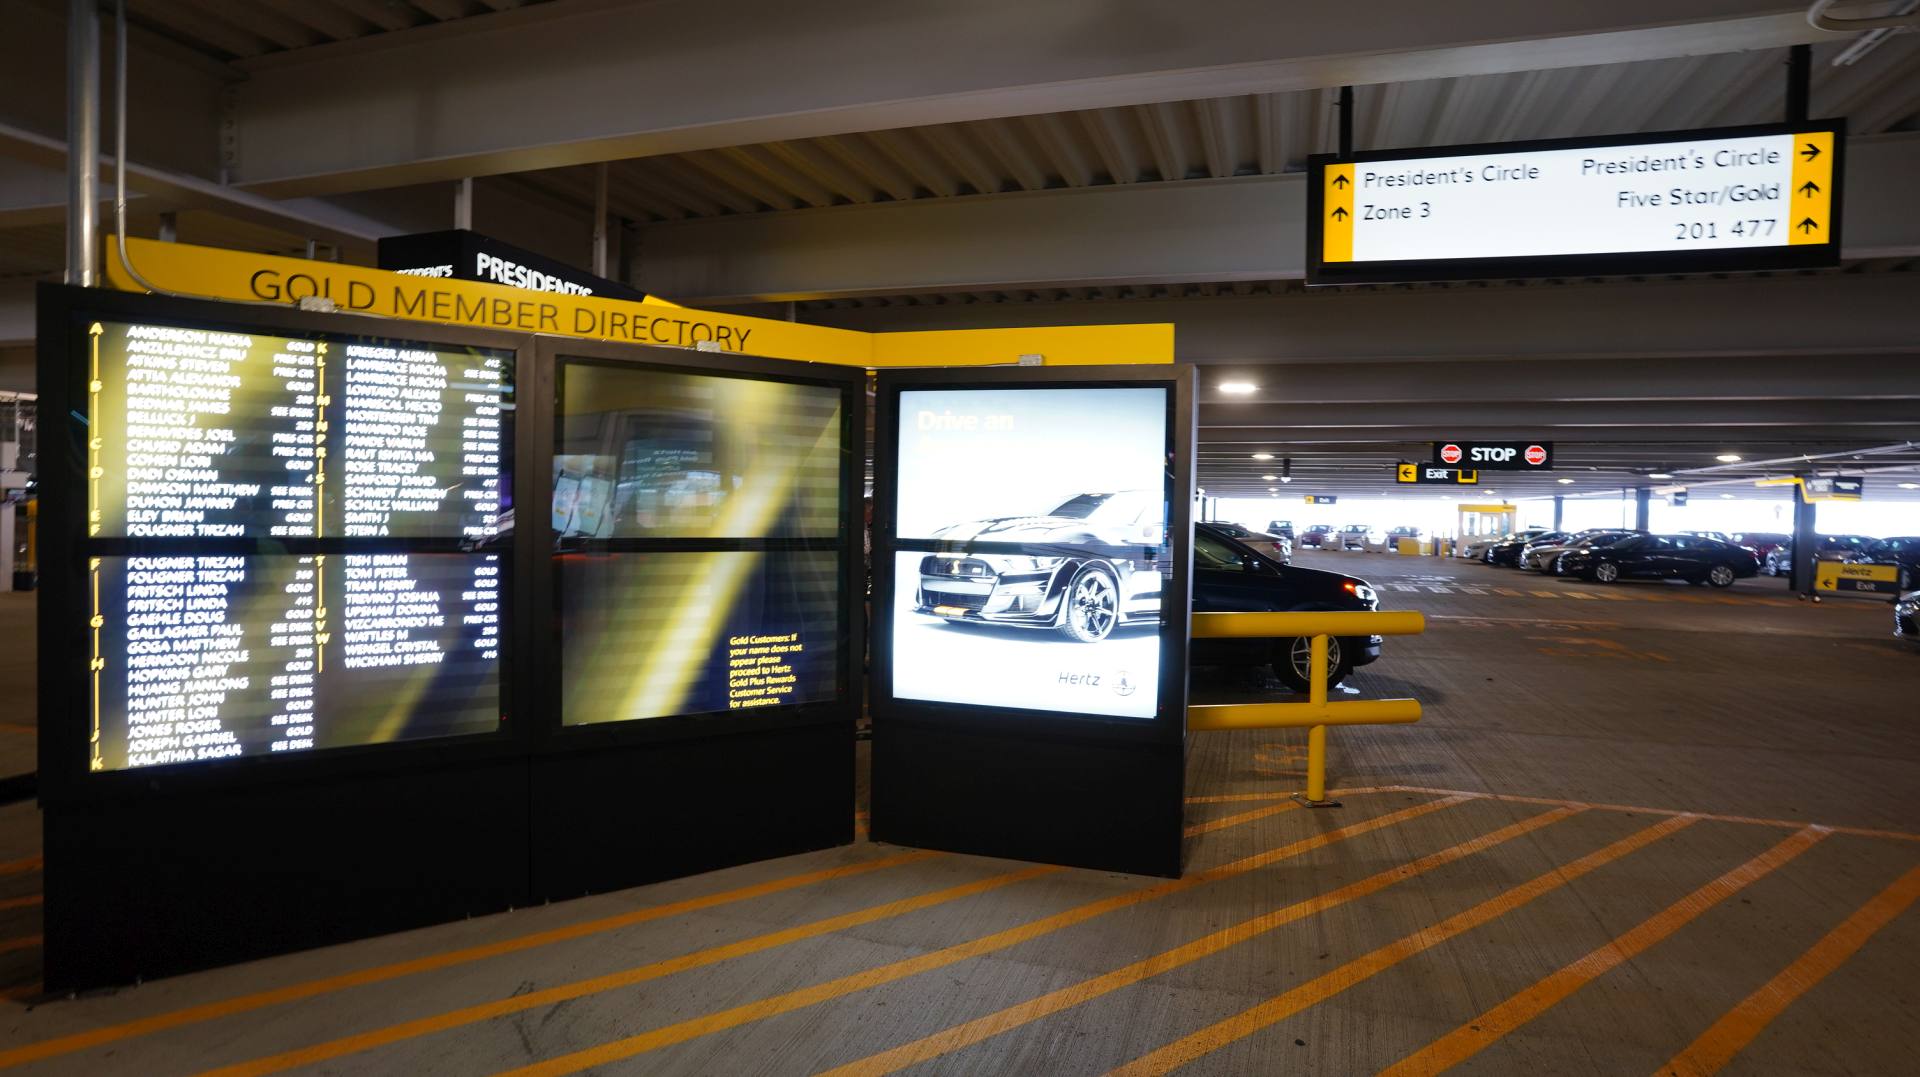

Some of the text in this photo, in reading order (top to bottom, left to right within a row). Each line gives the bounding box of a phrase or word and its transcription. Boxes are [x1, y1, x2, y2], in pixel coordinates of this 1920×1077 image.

[1581, 147, 1781, 176] President's Circle
[1364, 163, 1540, 190] President's Circle
[1617, 183, 1780, 209] Five Star/Gold
[1363, 202, 1431, 222] Zone 3
[1676, 219, 1777, 240] 201 477
[250, 269, 751, 351] GOLD MEMBER DIRECTORY
[917, 410, 1014, 432] Drive an
[1471, 447, 1516, 461] STOP
[1425, 468, 1449, 479] Exit
[1856, 581, 1876, 591] Exit
[730, 636, 748, 645] Gold
[730, 649, 747, 658] your
[771, 645, 788, 653] does
[772, 665, 791, 673] Hertz
[730, 678, 748, 687] Gold
[1058, 672, 1100, 686] Hertz
[730, 685, 792, 697] Customer Service
